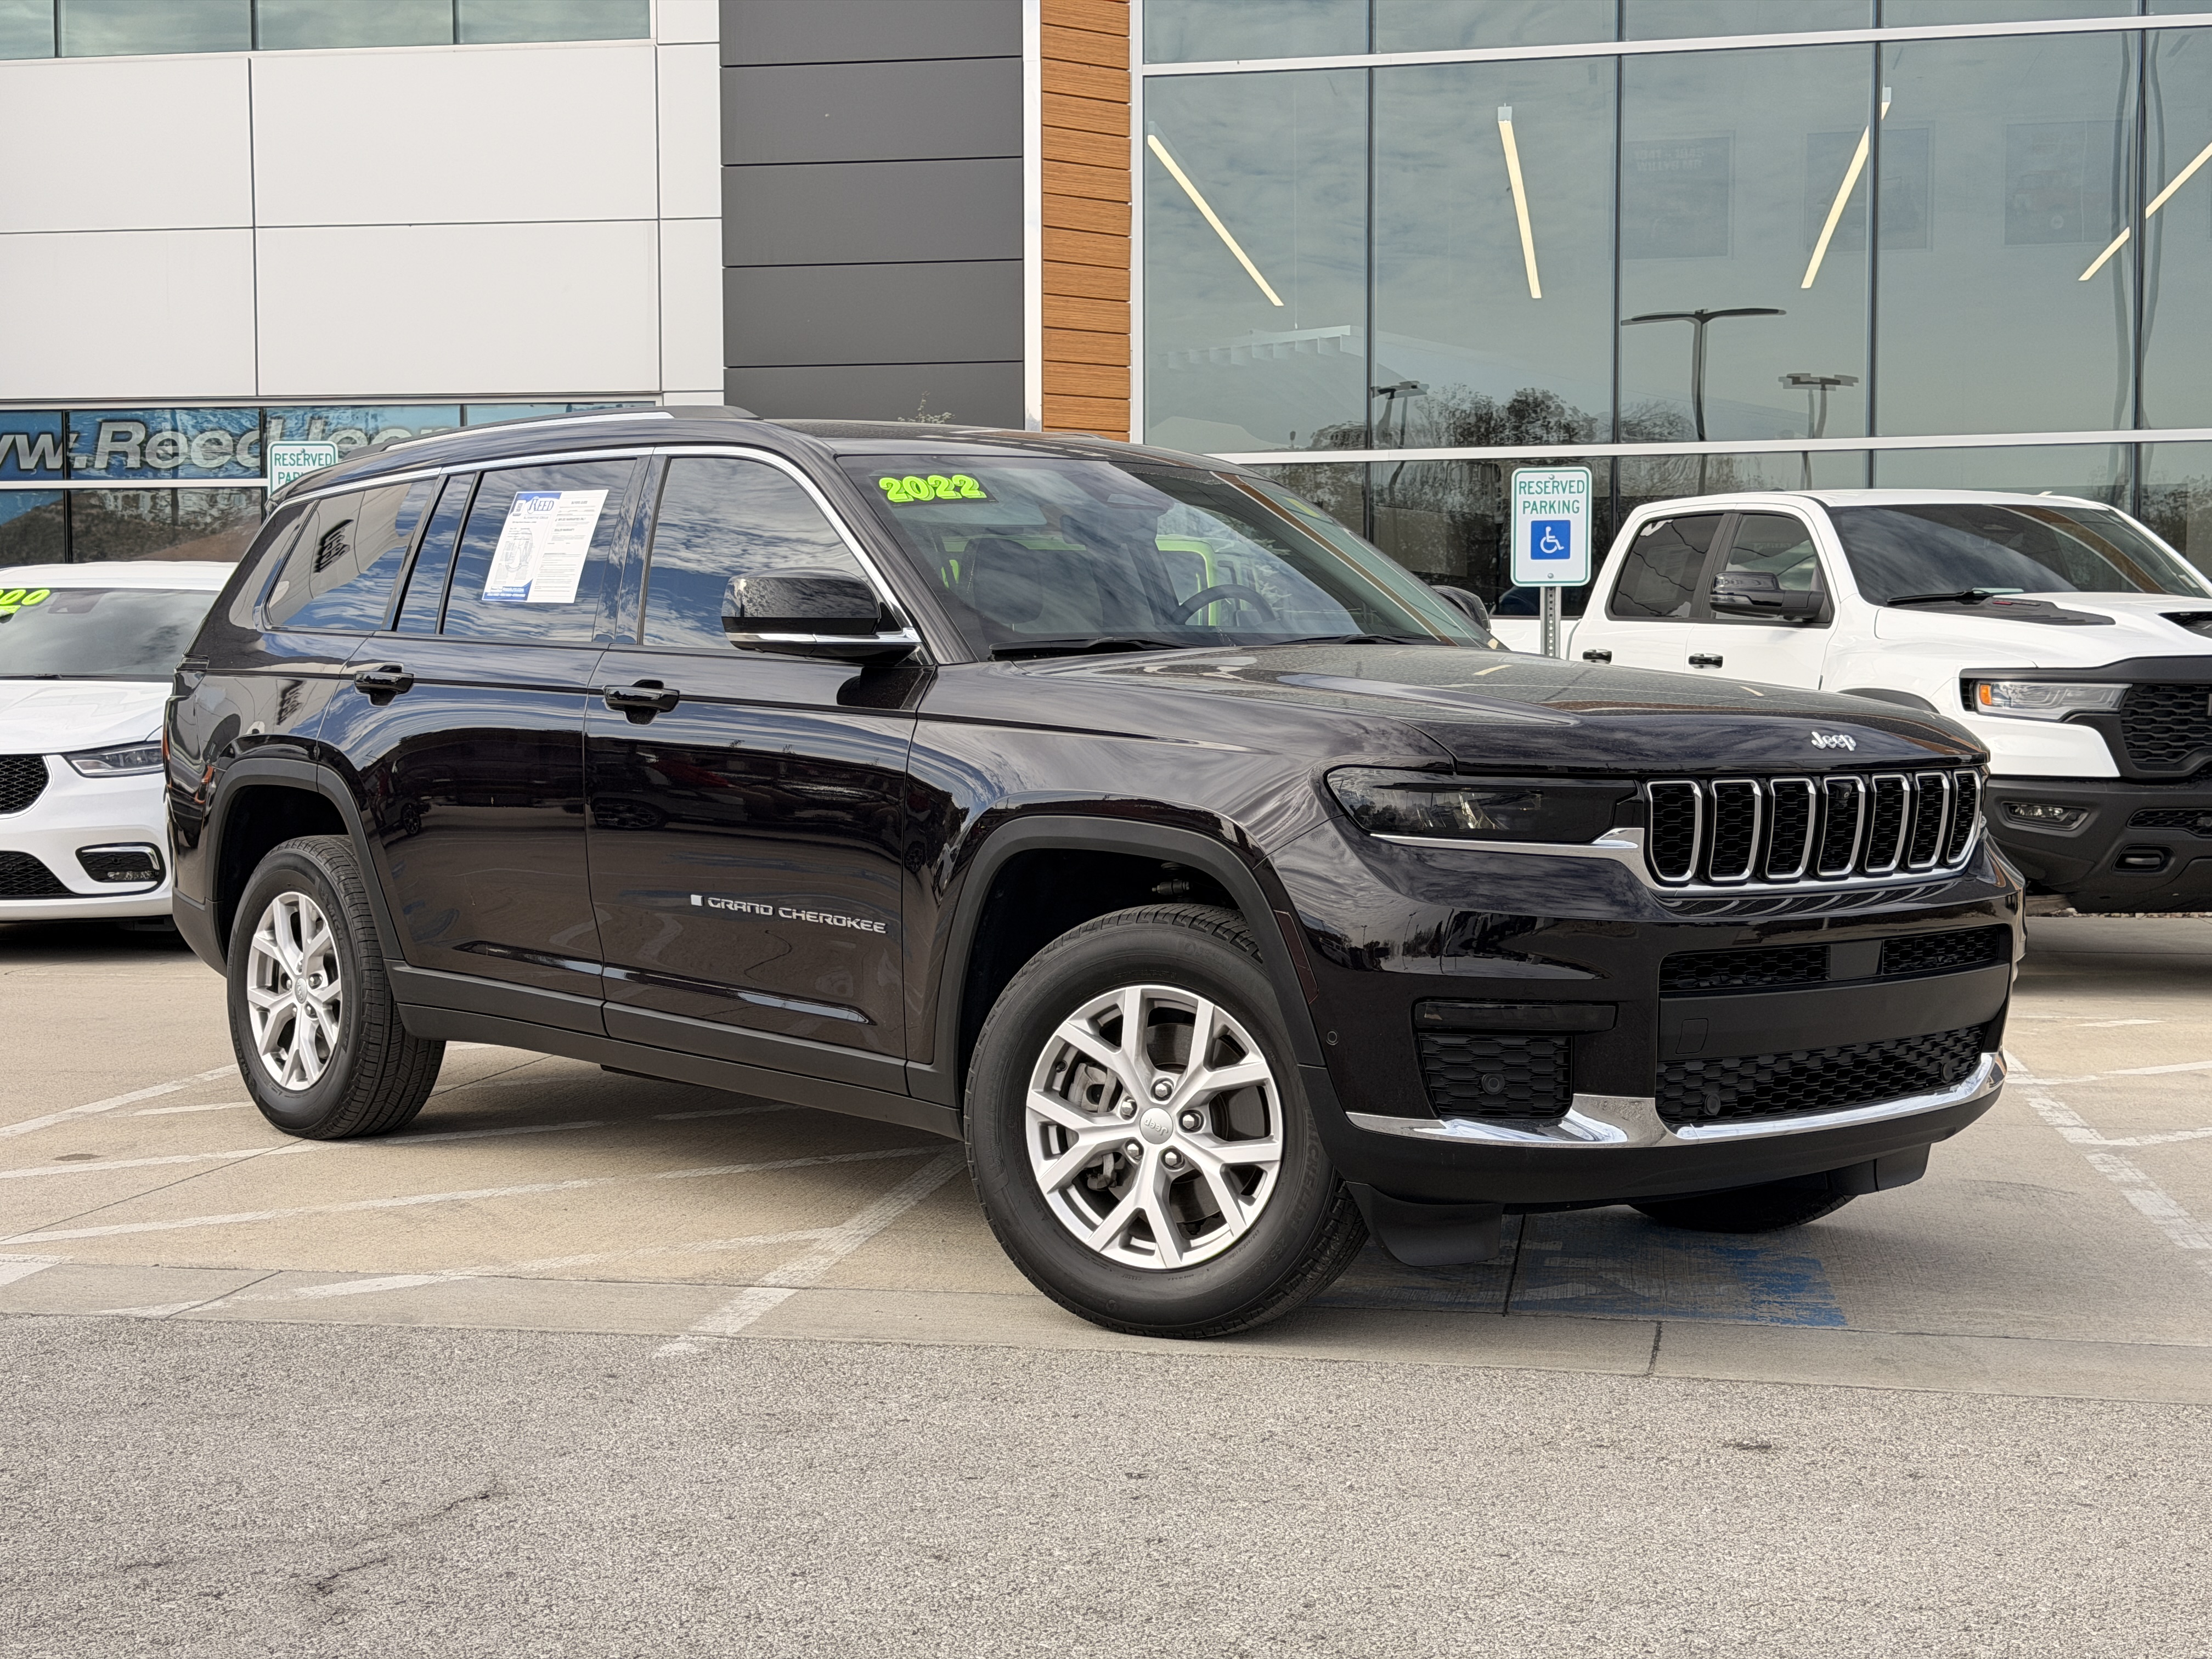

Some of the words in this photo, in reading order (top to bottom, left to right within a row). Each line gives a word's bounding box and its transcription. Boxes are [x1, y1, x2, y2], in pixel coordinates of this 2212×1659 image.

[274, 453, 332, 466] RESERVED
[879, 474, 988, 503] 2022
[1519, 479, 1585, 495] RESERVED
[528, 498, 554, 511] REED
[1522, 499, 1580, 515] PARKING
[1811, 731, 1857, 752] Jeep
[708, 897, 774, 916] GRAND
[778, 907, 887, 934] CHEROKEE
[1144, 1118, 1169, 1136] Jeep
